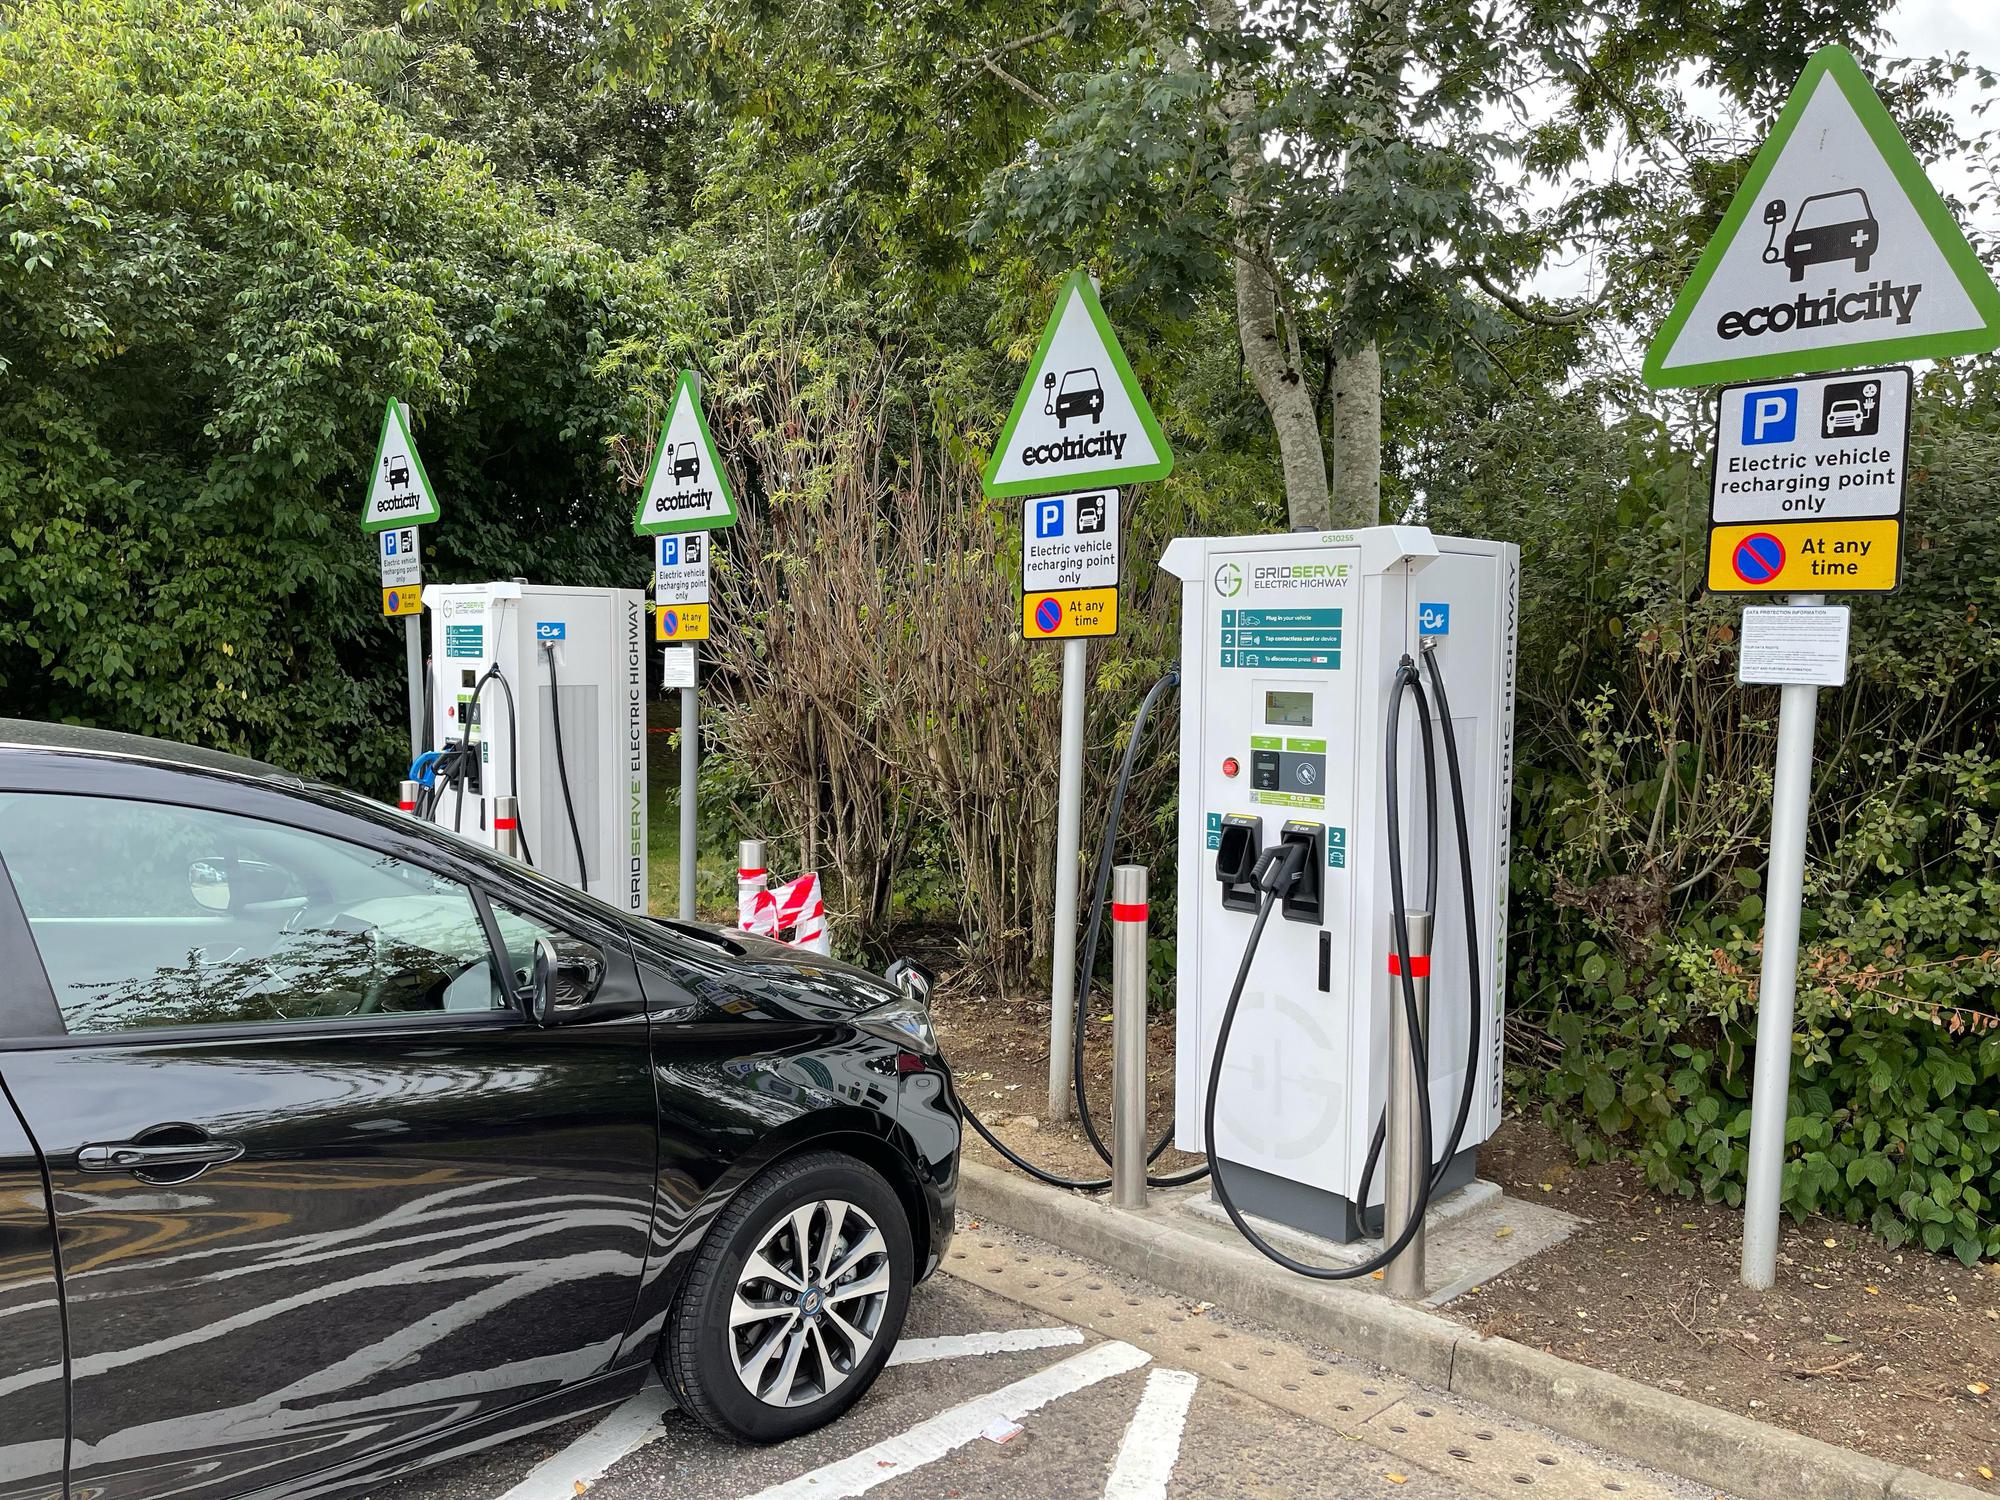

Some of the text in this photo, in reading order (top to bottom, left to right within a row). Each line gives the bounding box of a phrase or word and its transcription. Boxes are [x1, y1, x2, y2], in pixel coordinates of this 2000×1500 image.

[1717, 280, 1922, 340] ecotricity
[1753, 397, 1787, 440] P
[1022, 430, 1127, 467] ecotricity
[1728, 447, 1891, 473] Electric vehicle
[1721, 468, 1896, 494] recharging point
[377, 492, 420, 512] ecotricity
[656, 488, 713, 513] ecotricity
[1781, 494, 1826, 513] only
[1042, 505, 1059, 535] P
[387, 535, 394, 553] P
[1030, 540, 1112, 557] Electric vehicle
[1801, 538, 1872, 556] At any
[665, 541, 675, 564] P
[383, 556, 416, 567] Electric vehicle
[1027, 554, 1115, 571] recharging point
[1811, 559, 1858, 576] time
[383, 565, 418, 576] recharging point
[659, 568, 705, 580] Electric vehicle
[1058, 571, 1081, 584] only
[1254, 564, 1348, 579] GRIDSERVE
[657, 579, 707, 591] recharging point
[1254, 578, 1348, 589] ELECTRIC HIGHWAY
[675, 591, 689, 600] only
[1069, 601, 1105, 613] At any
[682, 613, 702, 622] At any
[1074, 615, 1099, 626] time
[1226, 614, 1231, 623] 1
[1224, 634, 1232, 644] 2
[1265, 635, 1274, 643] Tap
[1224, 654, 1231, 663] 3
[1500, 720, 1510, 866] ELECTRIC
[1505, 560, 1516, 712] HIGHWAY
[628, 600, 641, 909] GRIDSERVE ELECTRIC HIGHWAY
[1211, 817, 1216, 827] 1
[1333, 832, 1341, 843] 2
